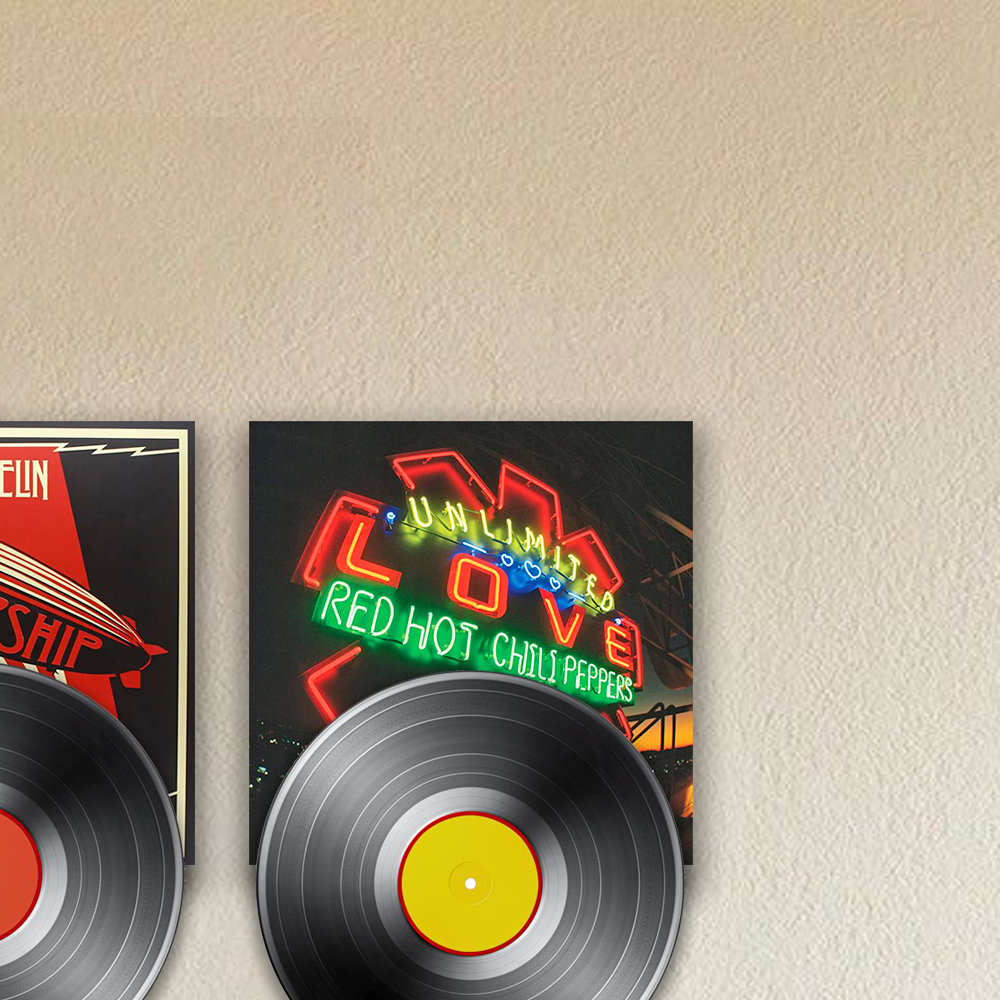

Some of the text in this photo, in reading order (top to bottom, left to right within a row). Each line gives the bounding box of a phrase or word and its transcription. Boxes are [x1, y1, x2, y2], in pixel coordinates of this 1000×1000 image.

[336, 514, 633, 673] LOVE
[408, 496, 615, 612] UNLIMITED
[320, 580, 634, 704] RED HOT CHILI PEPPERS
